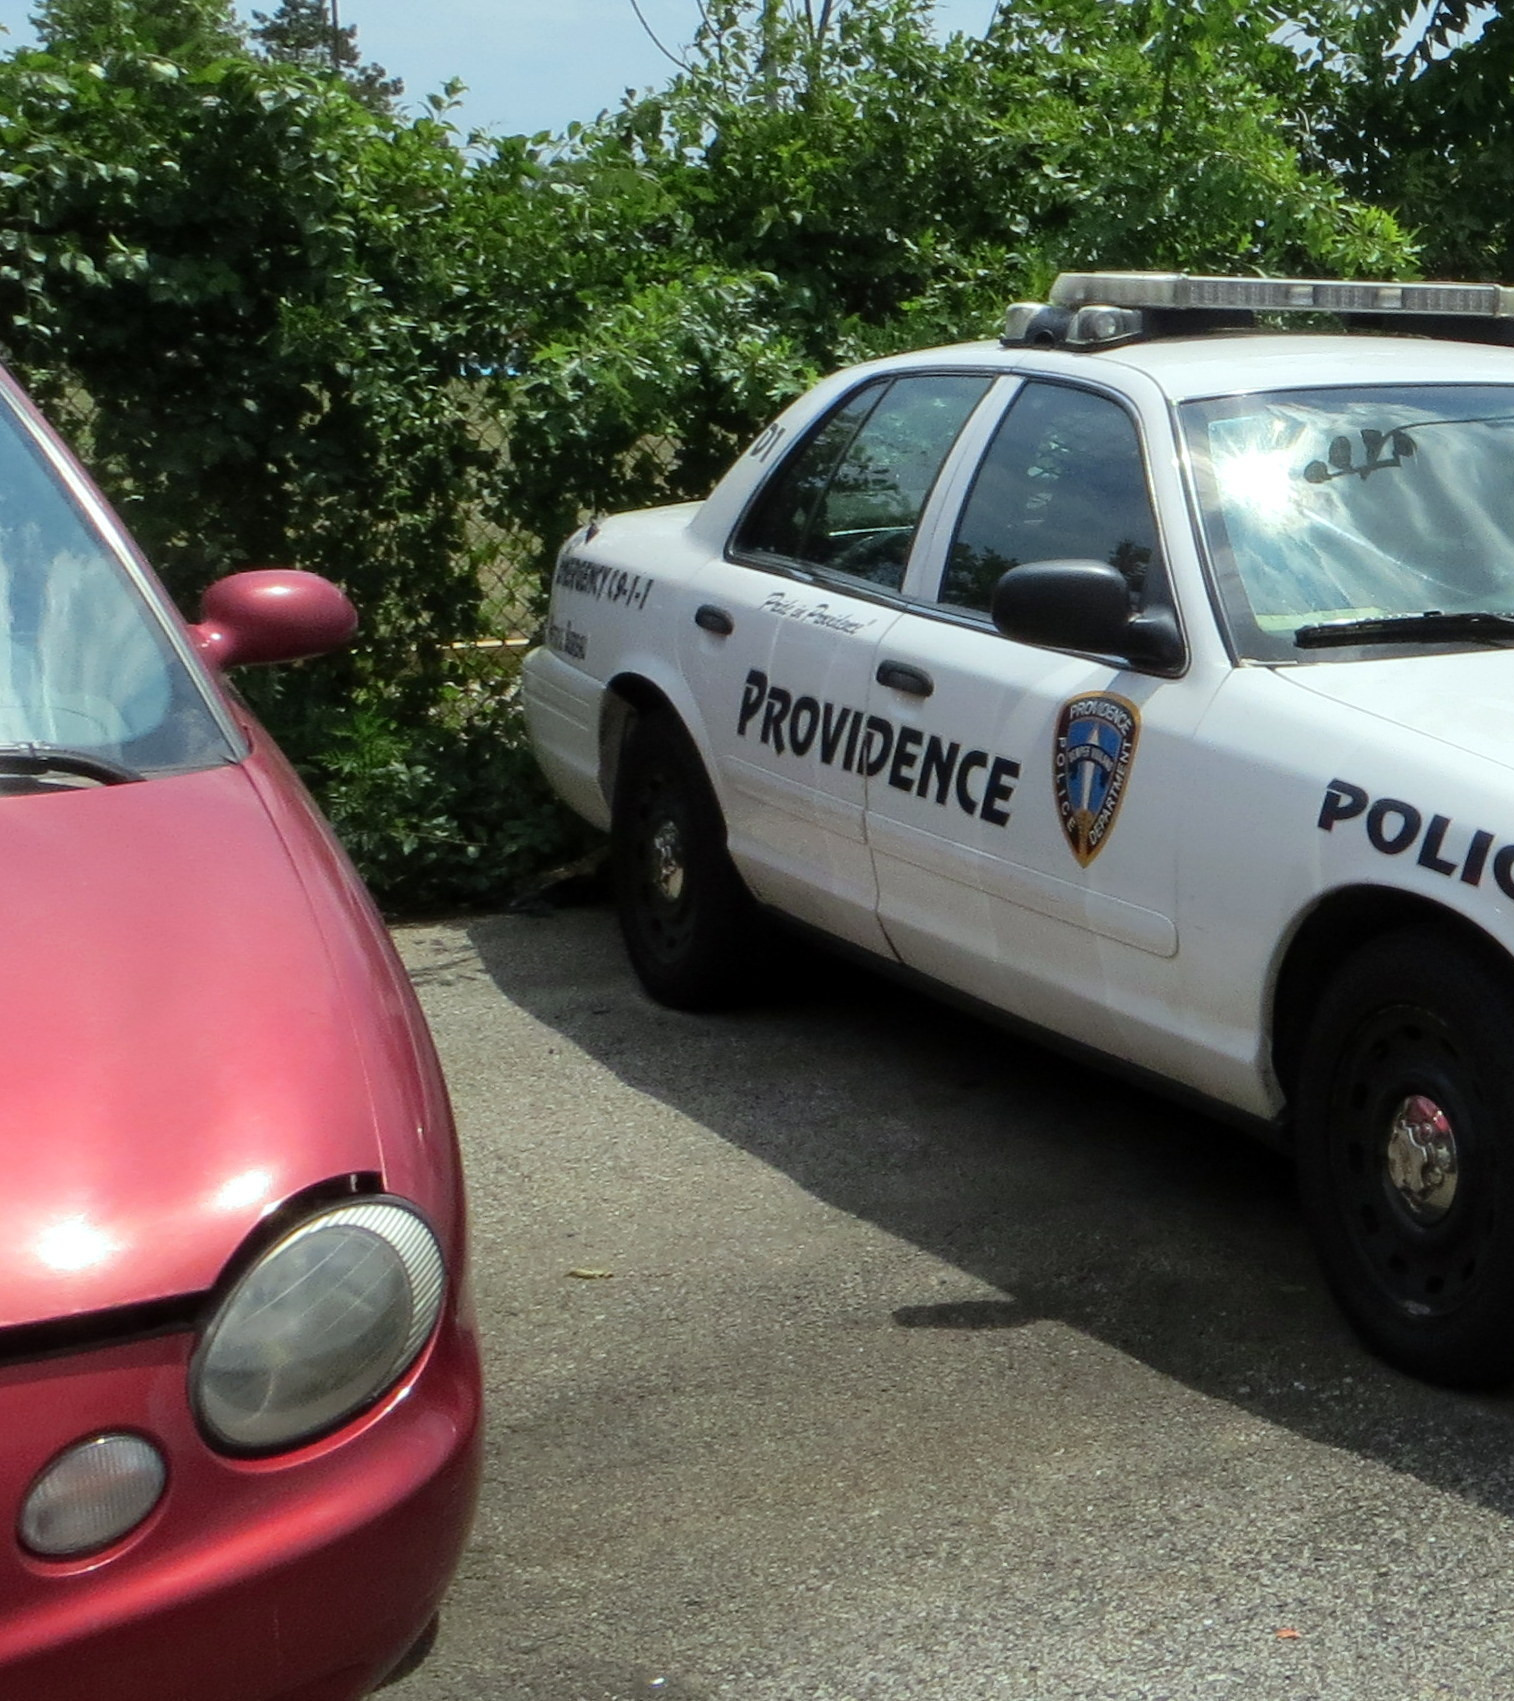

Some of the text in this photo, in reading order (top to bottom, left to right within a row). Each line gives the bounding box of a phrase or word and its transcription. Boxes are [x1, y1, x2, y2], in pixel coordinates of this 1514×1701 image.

[750, 422, 786, 463] 01
[737, 669, 1021, 827] PROVIDENCE
[1069, 701, 1132, 735] PROVIDENCE
[1056, 737, 1076, 832] POLICE
[1088, 742, 1132, 846] DEPARTMENT
